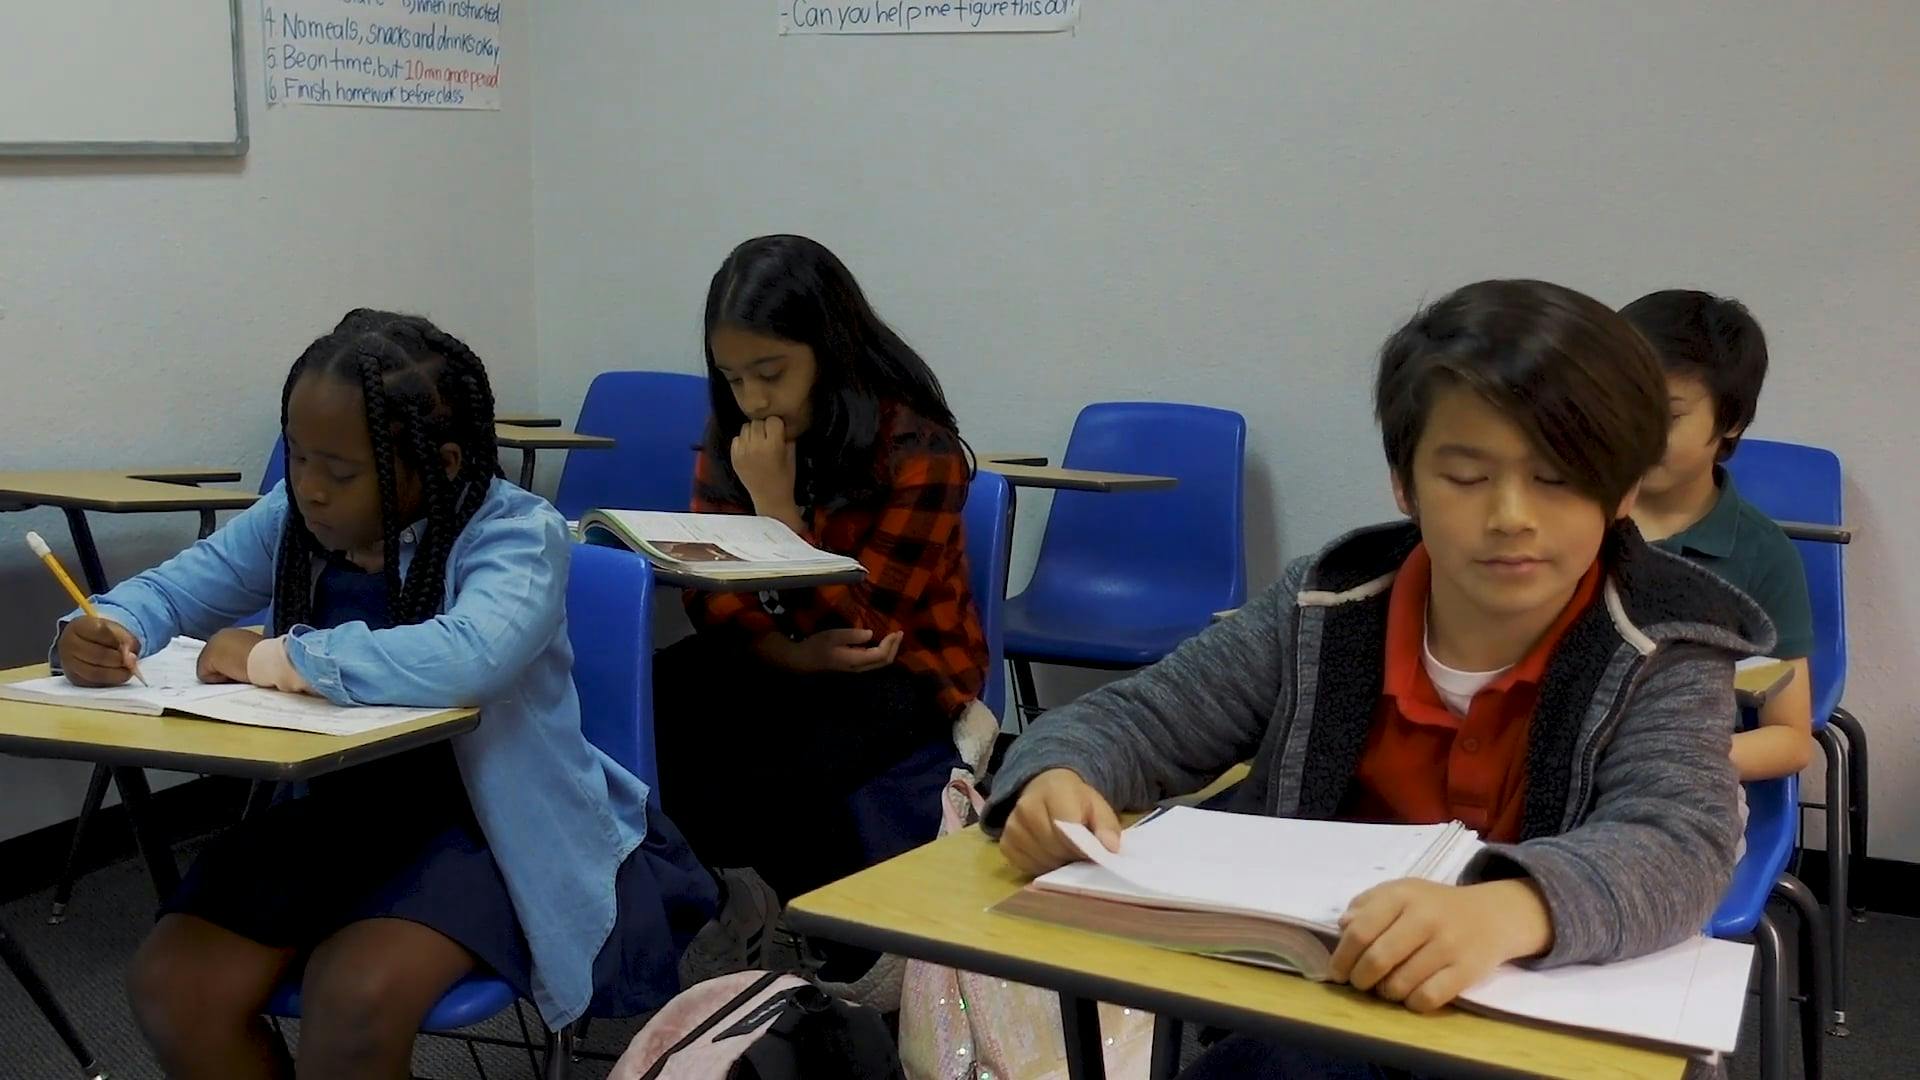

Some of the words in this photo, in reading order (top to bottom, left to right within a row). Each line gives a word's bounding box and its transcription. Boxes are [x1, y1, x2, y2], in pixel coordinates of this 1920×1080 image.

[283, 12, 307, 40] No
[308, 17, 363, 45] meals,
[366, 23, 411, 49] snacks
[412, 22, 436, 51] and
[793, 0, 833, 27] Can
[838, 6, 871, 31] you
[875, 0, 922, 31] help
[925, 3, 950, 17] me
[1012, 0, 1042, 16] this
[283, 44, 306, 70] Be
[307, 54, 328, 71] on
[404, 59, 424, 81] 10
[284, 77, 331, 101] Finish
[400, 83, 435, 104] before
[435, 86, 465, 104] class
